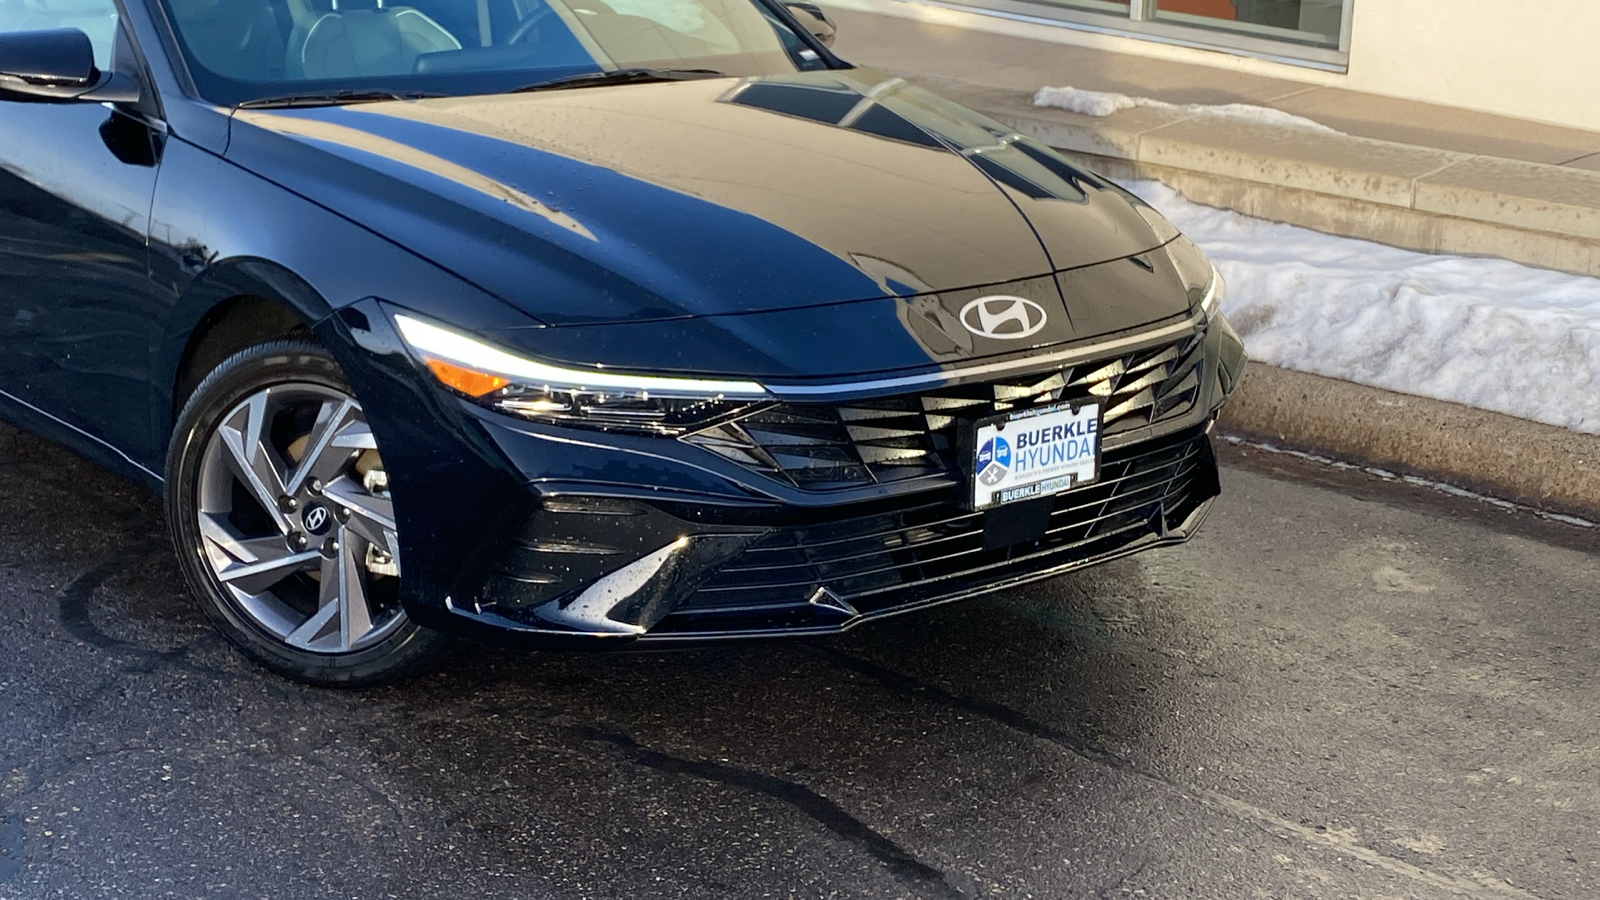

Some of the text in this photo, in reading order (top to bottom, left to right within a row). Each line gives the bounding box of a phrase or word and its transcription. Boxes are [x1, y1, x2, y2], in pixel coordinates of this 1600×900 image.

[1016, 418, 1097, 449] BUERKLE
[1002, 477, 1069, 502] BUERKLE HYUNDAI
